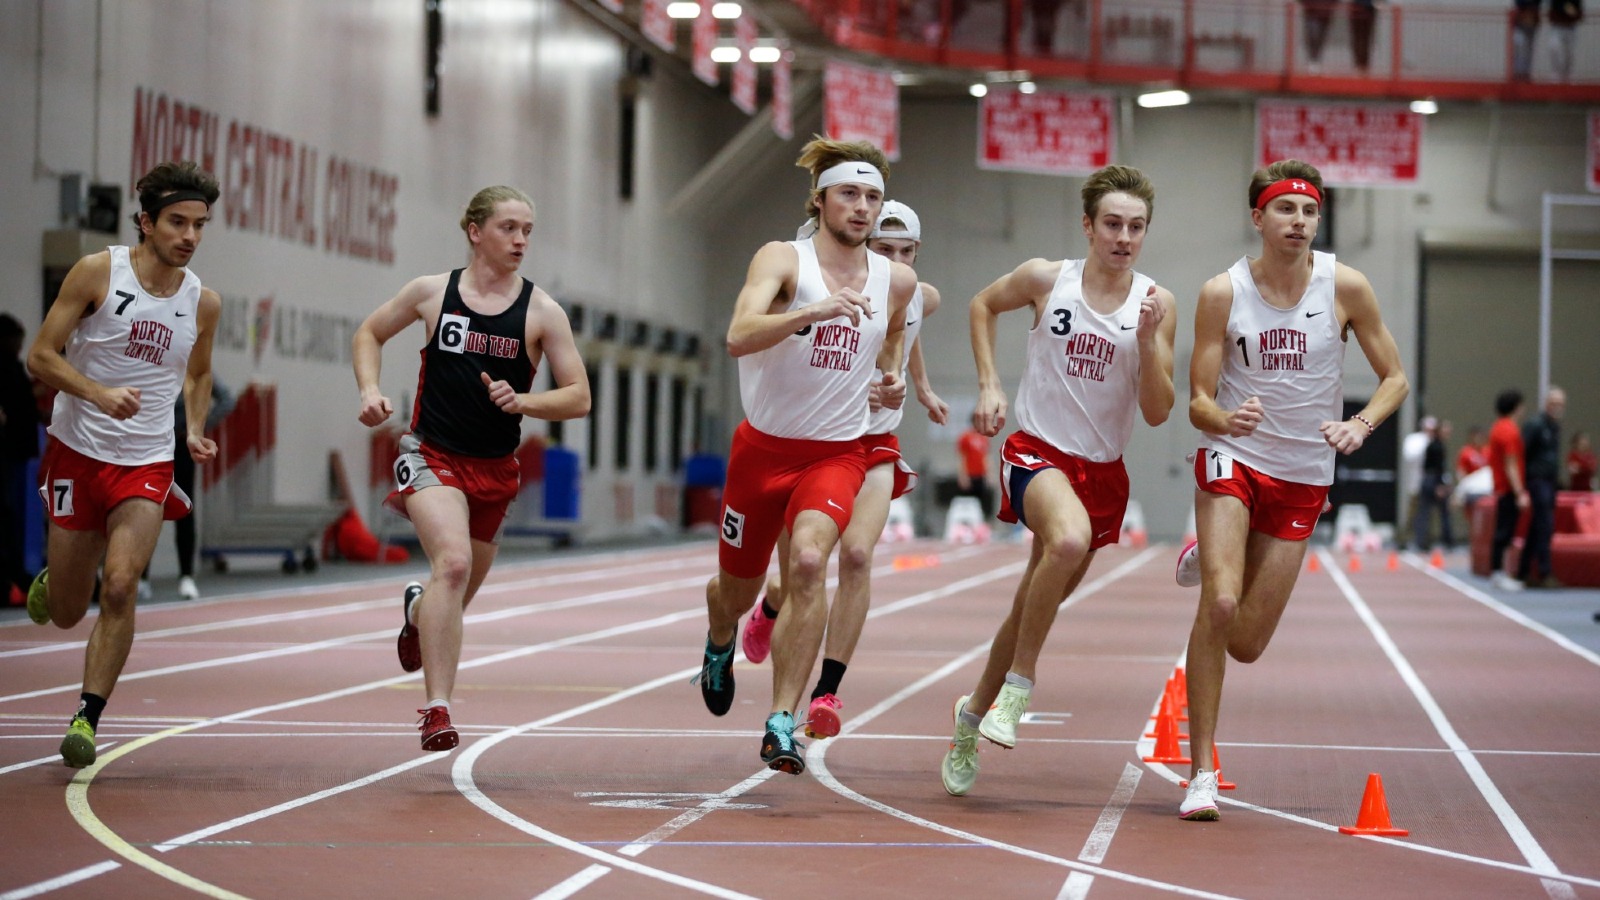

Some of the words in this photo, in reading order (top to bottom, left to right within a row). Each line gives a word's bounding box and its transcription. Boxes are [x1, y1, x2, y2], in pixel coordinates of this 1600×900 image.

[223, 118, 318, 248] CENTRAL
[323, 153, 398, 266] COLLEGE
[115, 290, 135, 316] 7
[128, 320, 174, 351] NORTH
[441, 321, 463, 348] 6
[1051, 308, 1072, 336] 3
[464, 331, 488, 354] OIS
[489, 335, 520, 358] TECH
[813, 324, 861, 354] NORTH
[1065, 333, 1116, 365] NORTH
[1236, 336, 1250, 368] 1
[1259, 328, 1307, 354] NORTH
[124, 341, 166, 366] CENTRAL
[810, 347, 853, 372] CENTRAL
[1262, 353, 1304, 371] CENTRAL
[1066, 356, 1106, 382] CENTRAL
[396, 459, 411, 486] 6
[1211, 450, 1223, 478] 1
[54, 485, 69, 511] 7
[722, 511, 739, 540] 5
